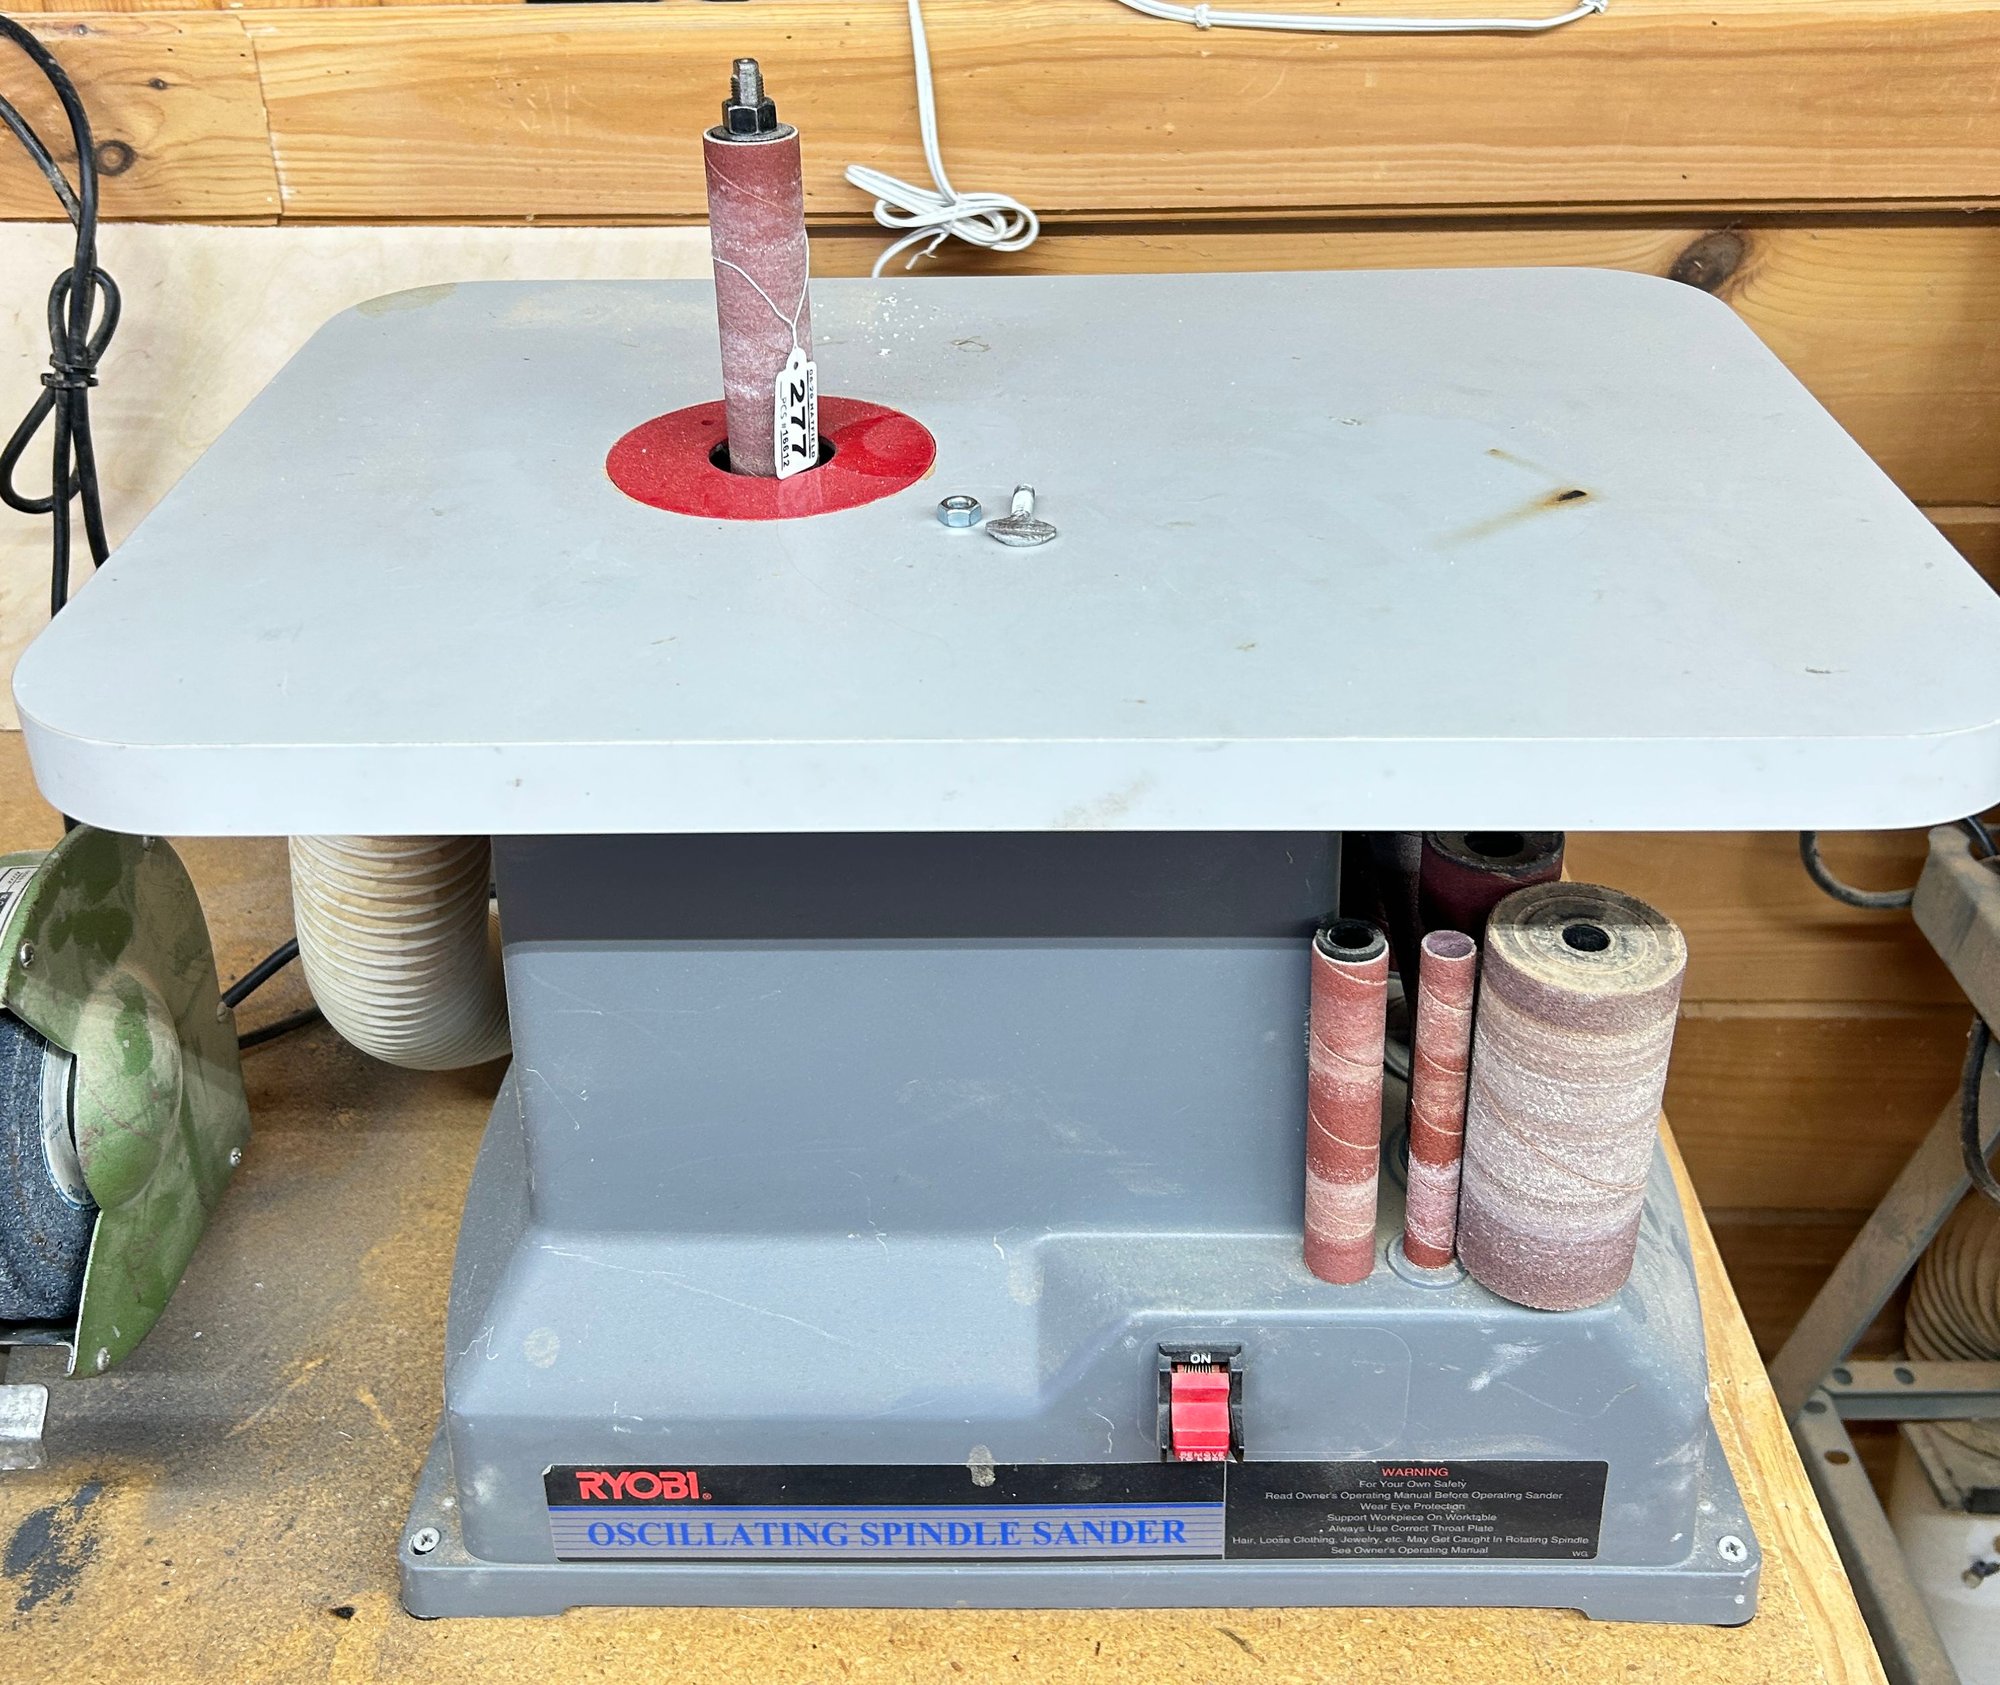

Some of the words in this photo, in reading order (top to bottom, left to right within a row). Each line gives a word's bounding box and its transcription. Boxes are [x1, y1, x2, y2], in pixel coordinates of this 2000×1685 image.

[790, 378, 807, 458] 277
[1190, 1353, 1212, 1364] ON
[1381, 1467, 1449, 1477] WARNING
[575, 1471, 700, 1500] RYOBI
[1359, 1480, 1377, 1488] For
[1379, 1480, 1404, 1488] Your
[1406, 1480, 1431, 1488] Own
[1433, 1480, 1467, 1489] Safety
[1265, 1492, 1293, 1500] Read
[1295, 1492, 1338, 1500] Owner's
[1340, 1491, 1391, 1501] Operating
[1394, 1491, 1432, 1499] Manual
[1434, 1491, 1469, 1499] Before
[1471, 1491, 1523, 1501] Operating
[1525, 1491, 1563, 1499] Sander
[1391, 1503, 1410, 1512] Eye
[1413, 1502, 1466, 1511] Protection
[1327, 1514, 1367, 1523] Support
[1370, 1514, 1424, 1523] Workpiece
[1445, 1513, 1497, 1522] Worktable
[587, 1521, 848, 1547] OSCILLATING
[860, 1520, 1021, 1547] SPINDLE
[1032, 1519, 1187, 1546] SANDER
[1328, 1525, 1365, 1534] Always
[1367, 1525, 1389, 1533] Use
[1391, 1525, 1429, 1533] Correct
[1260, 1537, 1291, 1545] Loose
[1406, 1536, 1429, 1545] May
[1453, 1536, 1491, 1545] Caught
[1505, 1536, 1548, 1546] Rotating
[1550, 1536, 1589, 1546] Spindle
[1397, 1547, 1448, 1556] Operating
[1450, 1546, 1489, 1554] Manual
